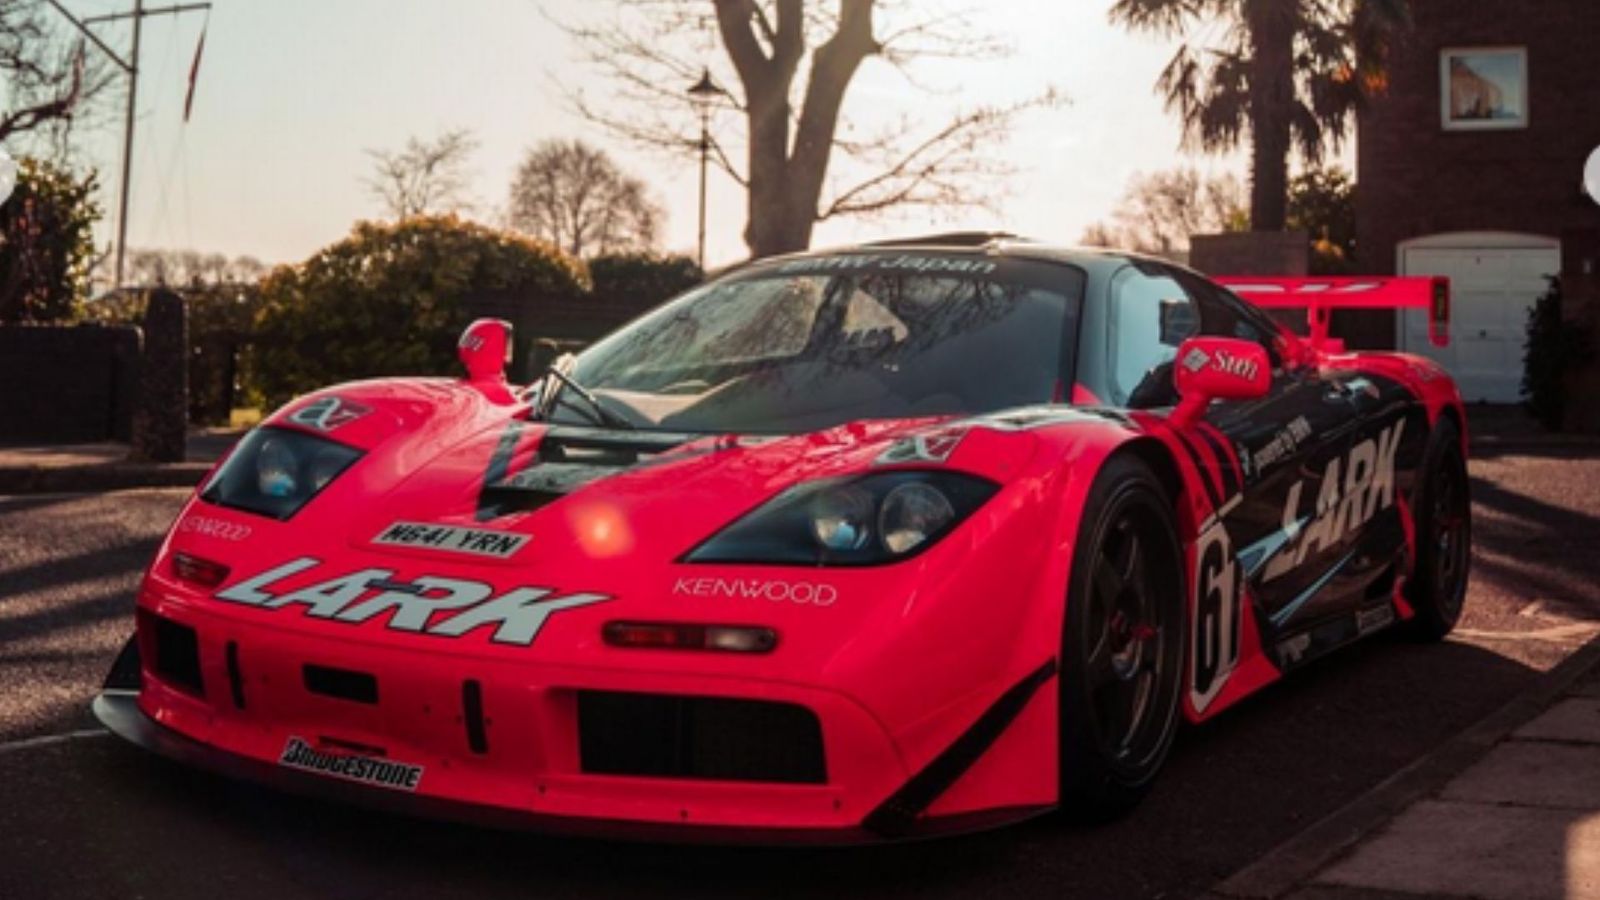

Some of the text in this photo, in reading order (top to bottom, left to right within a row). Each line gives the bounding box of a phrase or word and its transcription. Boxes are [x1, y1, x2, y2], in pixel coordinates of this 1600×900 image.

[879, 254, 996, 273] Japan
[1211, 348, 1258, 381] Sun
[1264, 415, 1406, 582] LARK
[457, 530, 523, 554] YRN
[214, 557, 614, 646] LARK
[672, 577, 838, 606] KENWOOD
[1195, 537, 1240, 695] 61
[283, 738, 421, 788] BRIDGESTONE
